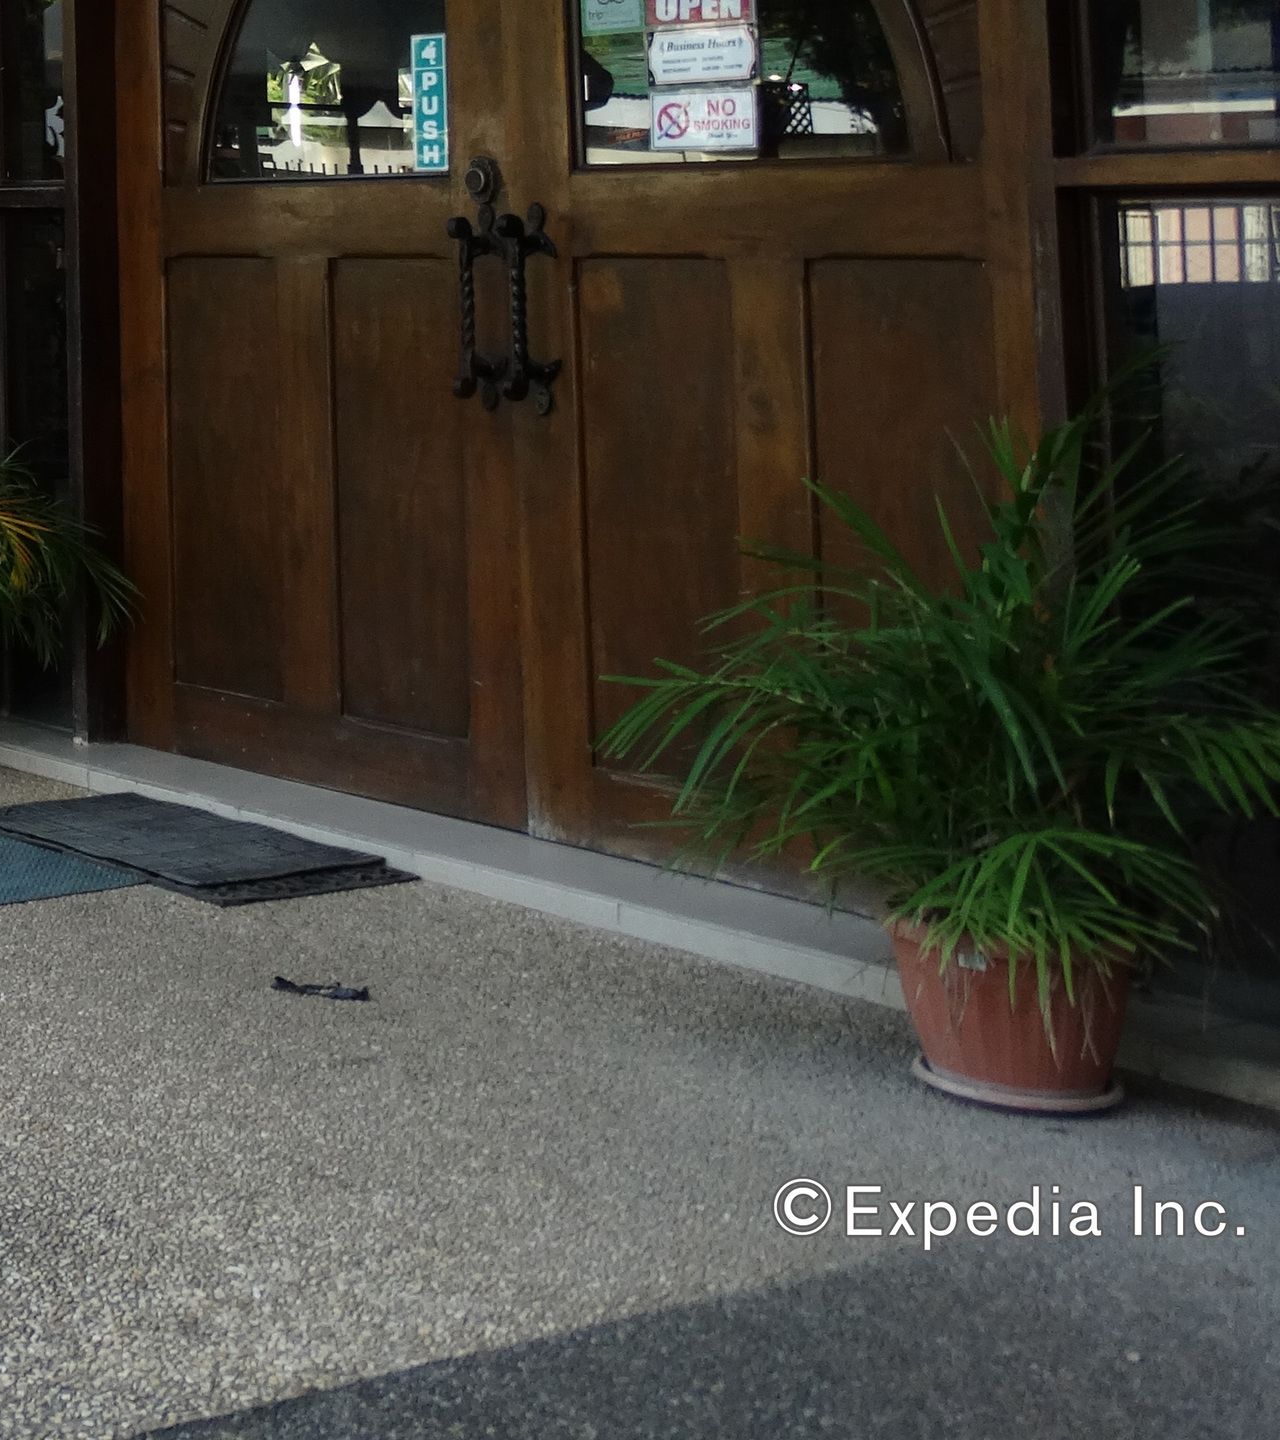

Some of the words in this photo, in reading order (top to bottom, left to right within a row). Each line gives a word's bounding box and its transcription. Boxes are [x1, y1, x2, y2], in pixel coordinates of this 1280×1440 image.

[667, 40, 704, 52] Business
[707, 38, 736, 49] Hours
[707, 98, 736, 116] NO
[421, 71, 439, 164] PUSH
[694, 119, 750, 131] SMOKING
